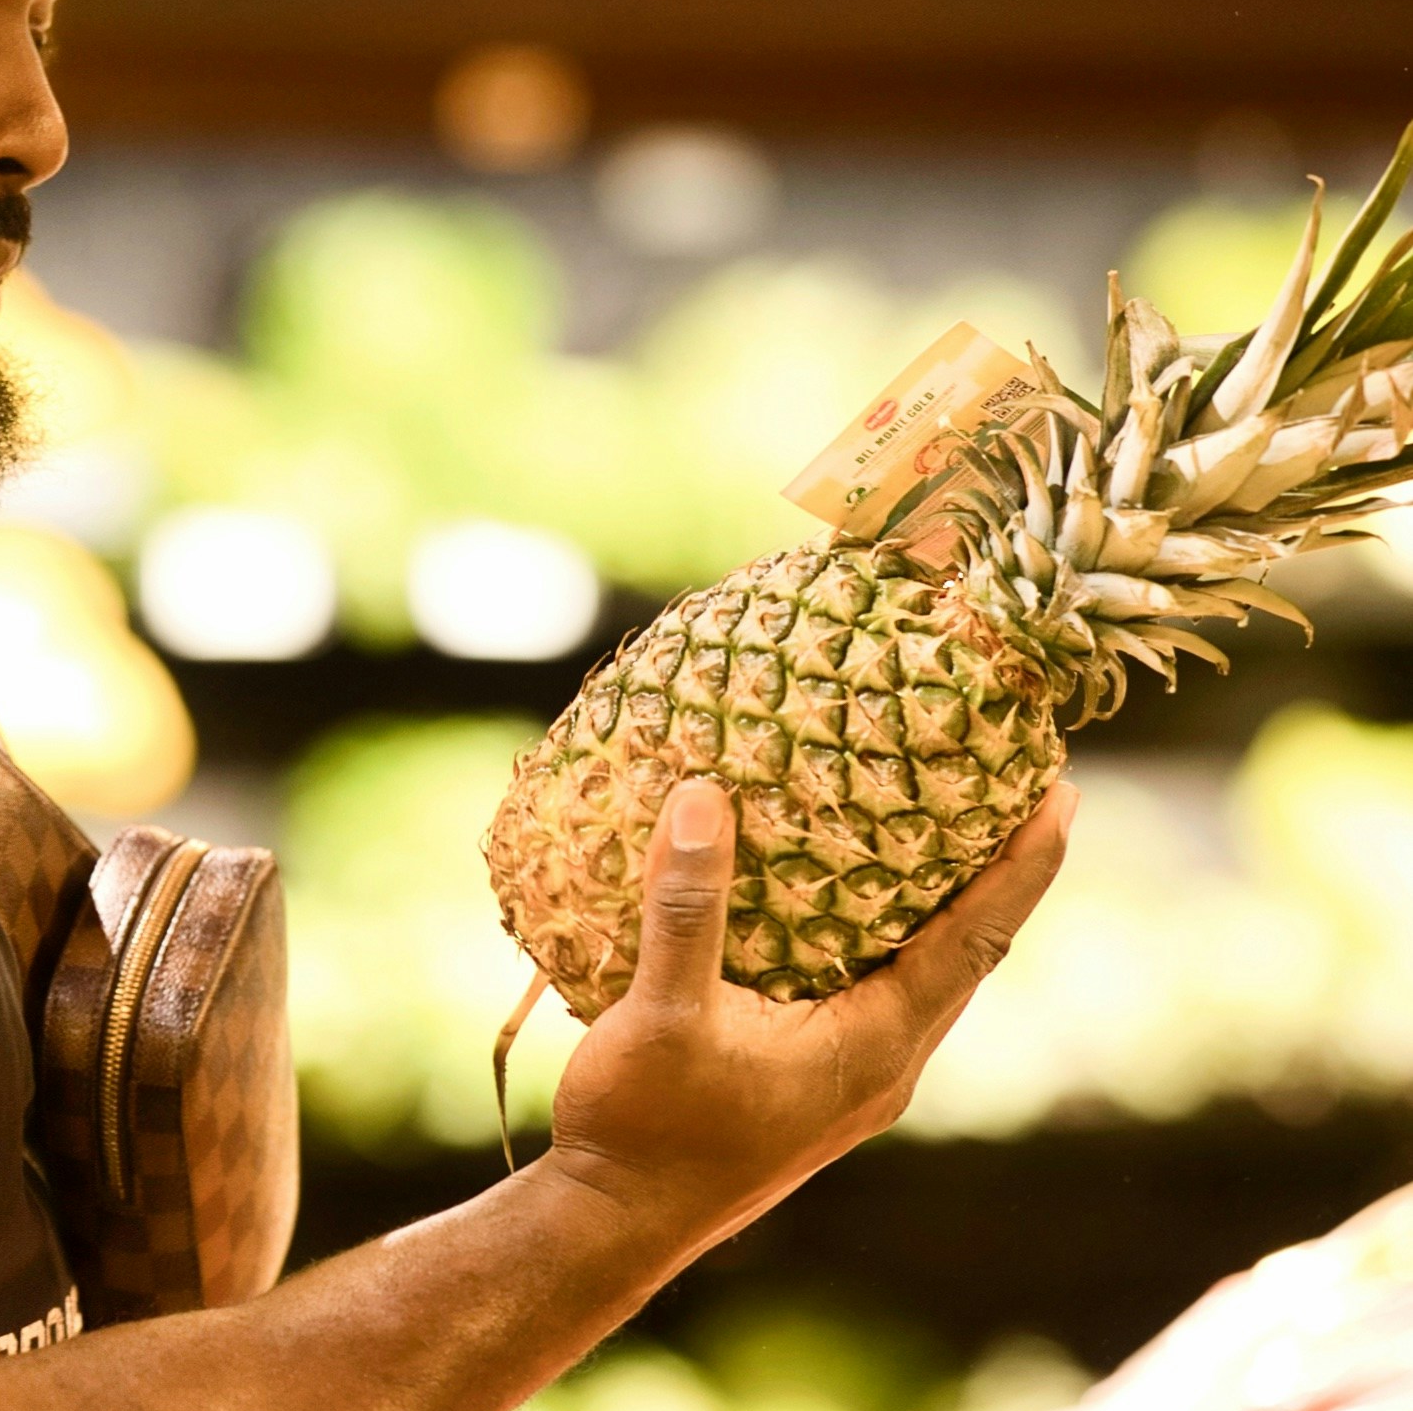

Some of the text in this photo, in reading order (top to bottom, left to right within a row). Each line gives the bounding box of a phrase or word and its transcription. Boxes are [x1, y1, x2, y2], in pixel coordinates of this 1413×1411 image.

[855, 391, 935, 464] DEL MONTE GOLD
